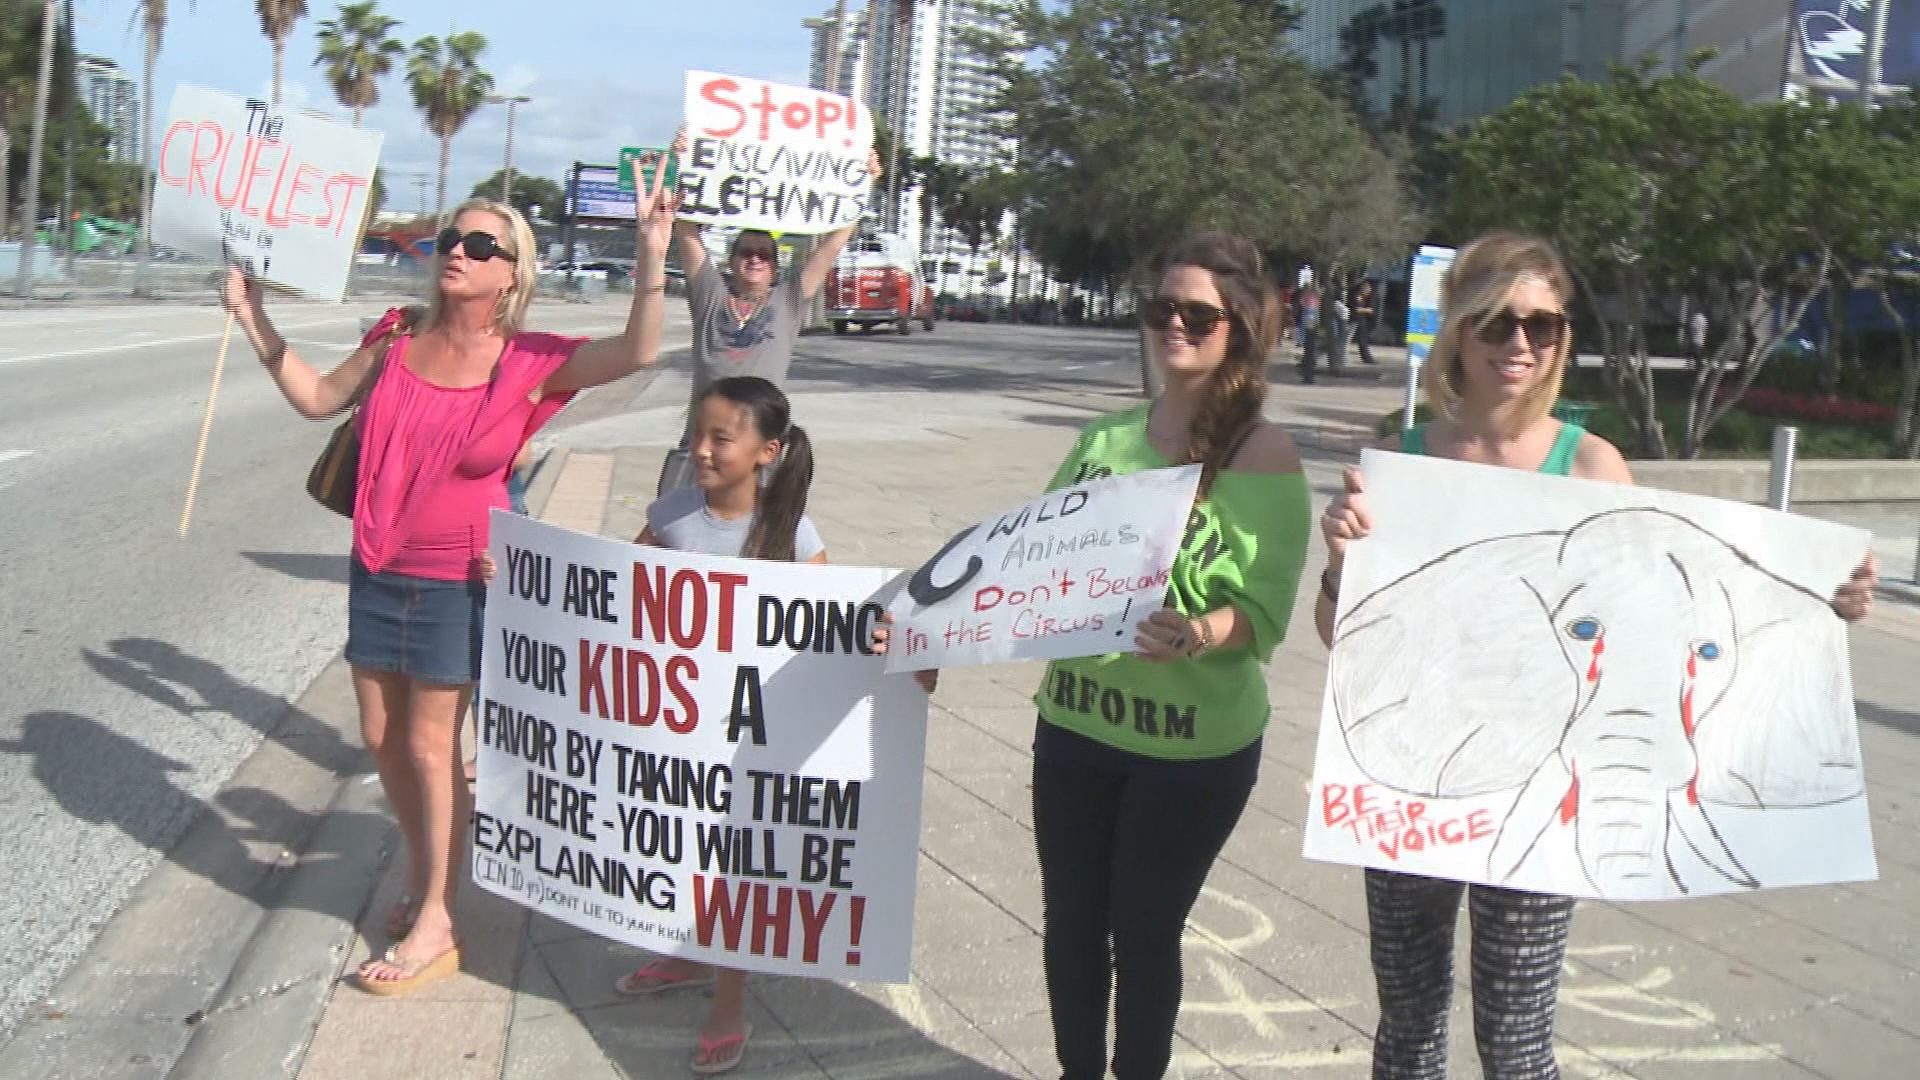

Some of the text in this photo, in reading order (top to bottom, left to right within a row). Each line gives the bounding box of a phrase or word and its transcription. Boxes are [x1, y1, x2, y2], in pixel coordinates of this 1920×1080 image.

[160, 120, 368, 240] CRUELEST
[676, 172, 868, 225] ELEPHANTS
[692, 138, 868, 187] ENSLAVING
[986, 491, 1089, 544] WILD
[505, 544, 884, 656] YOU ARE NOT DOING
[972, 568, 1076, 613] Don't
[501, 626, 768, 747] YOUR KIDS A
[1050, 668, 1199, 742] RFORM
[483, 697, 862, 831] FAVOR BY TAKING THEM
[526, 768, 597, 842] HERE
[695, 821, 788, 880] WILL
[800, 833, 856, 890] BE
[1322, 783, 1382, 829] BE
[474, 811, 676, 913] EXPLAINING
[584, 900, 601, 919] LIE
[604, 908, 625, 926] TO
[626, 916, 654, 933] your
